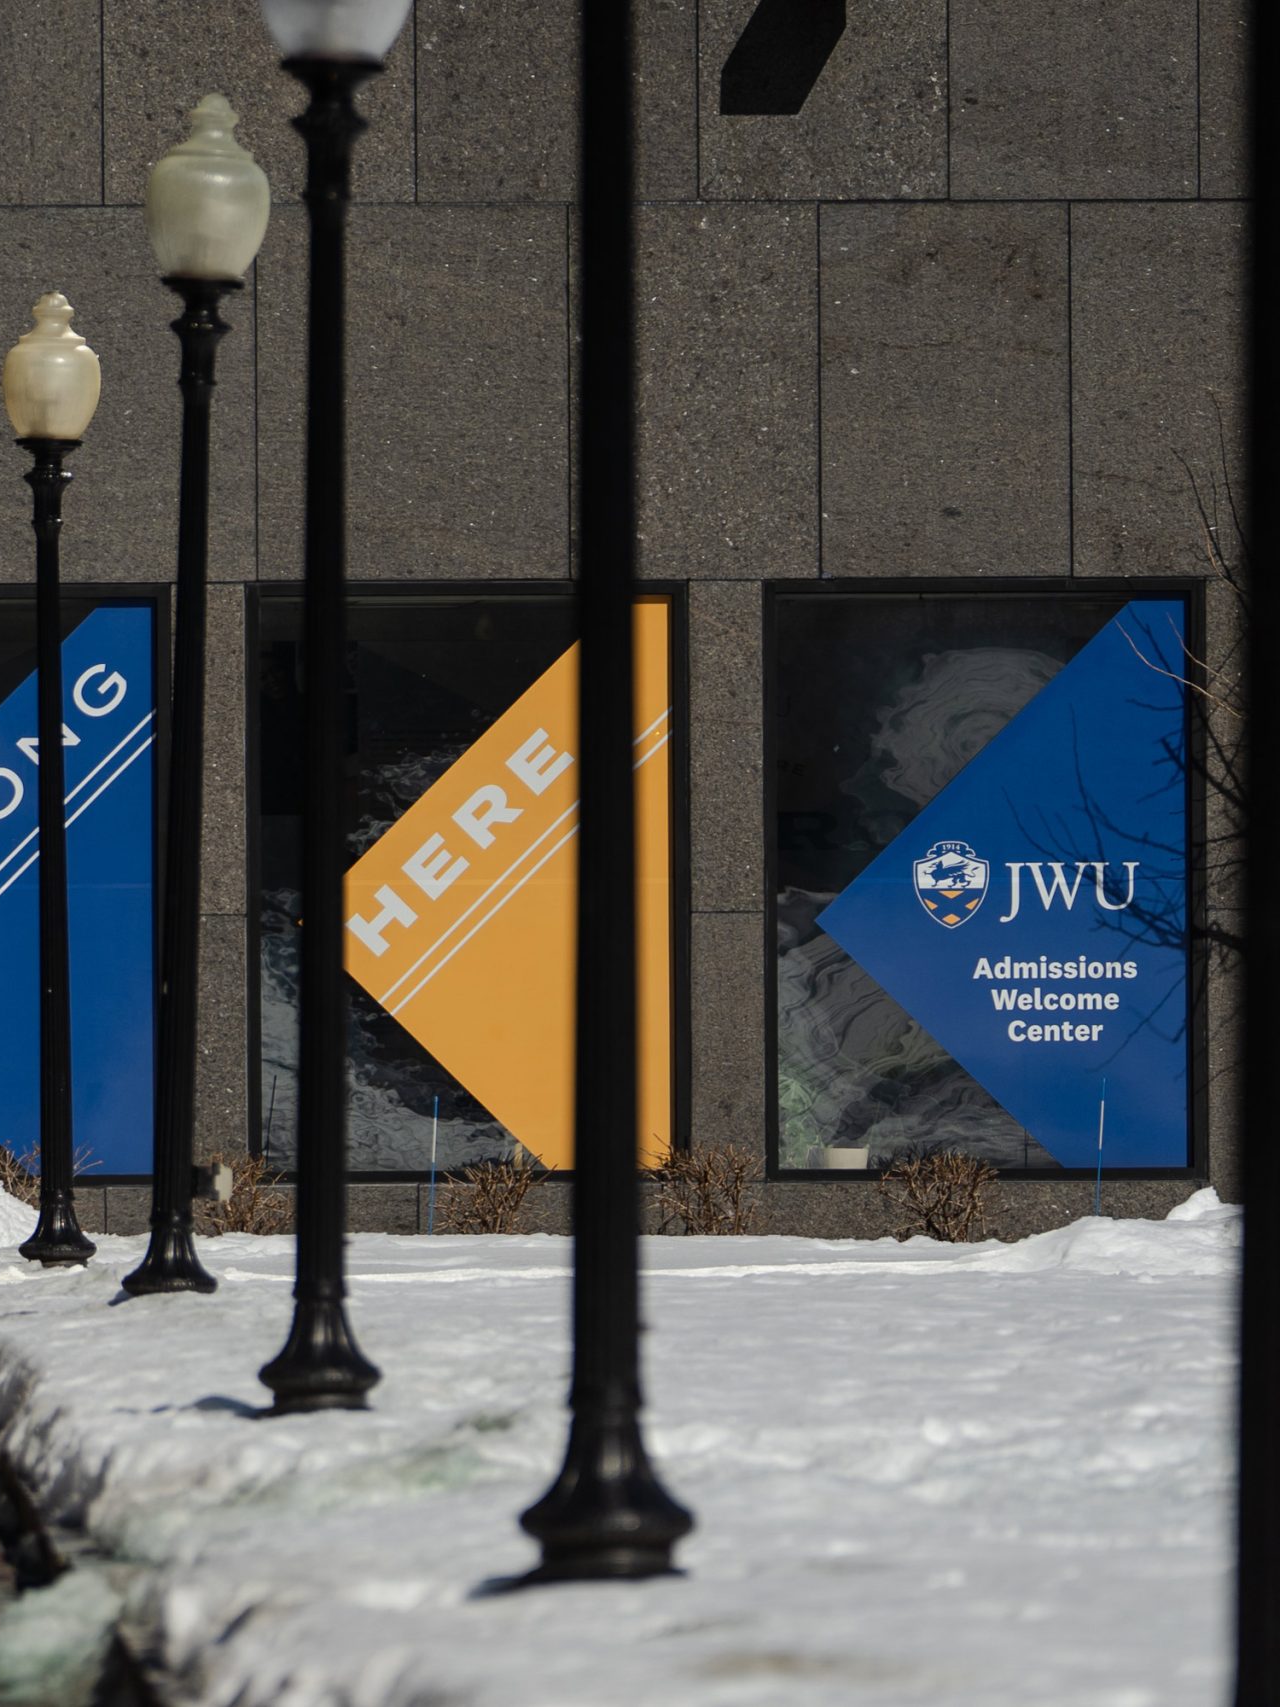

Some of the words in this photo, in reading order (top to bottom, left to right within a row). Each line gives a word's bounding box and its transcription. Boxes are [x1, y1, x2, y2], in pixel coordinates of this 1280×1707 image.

[345, 727, 575, 958] HERE
[999, 861, 1140, 923] JWU
[972, 955, 1137, 979] Admissions
[991, 987, 1119, 1010] Welcome
[1008, 1020, 1103, 1042] Center
